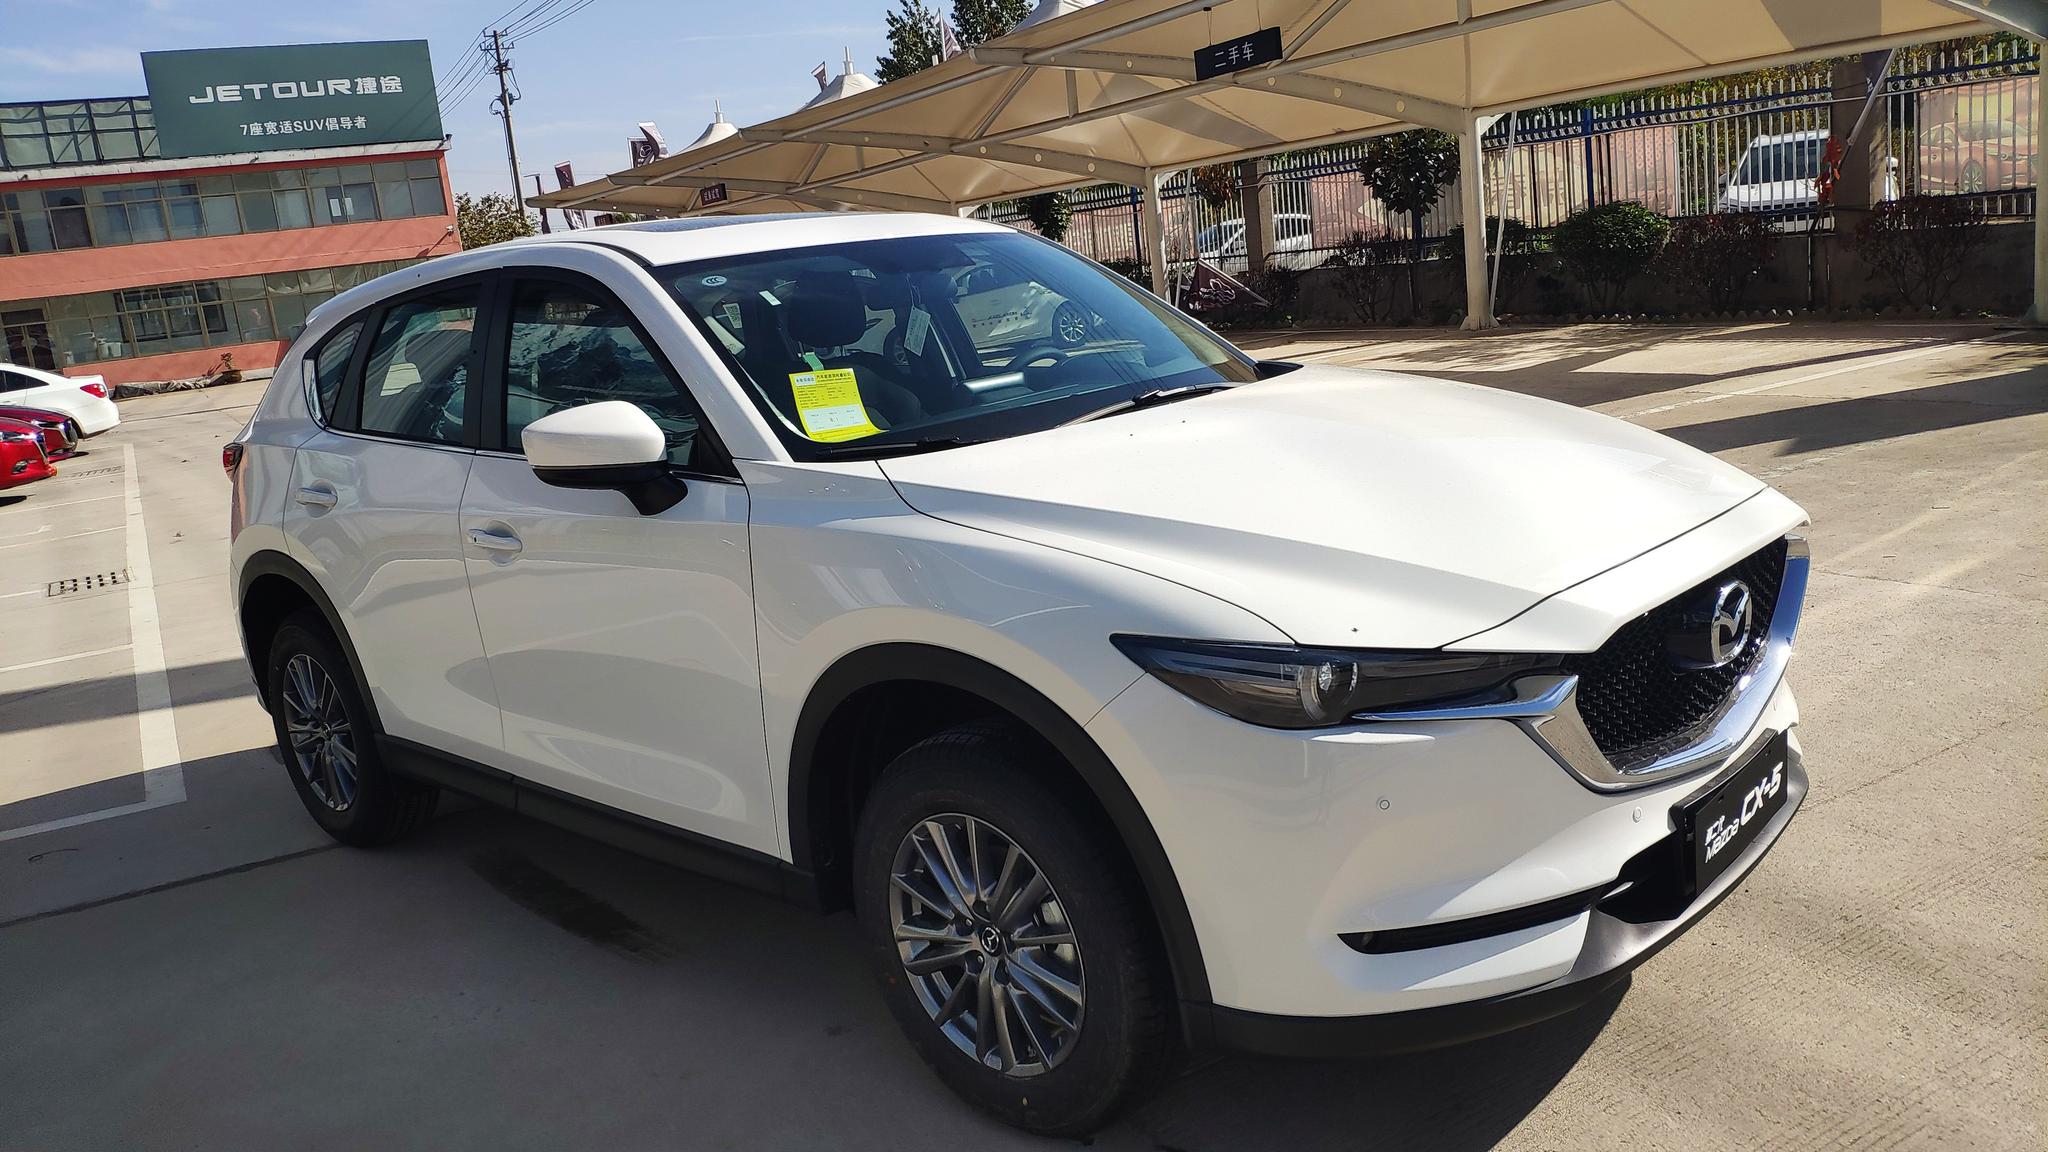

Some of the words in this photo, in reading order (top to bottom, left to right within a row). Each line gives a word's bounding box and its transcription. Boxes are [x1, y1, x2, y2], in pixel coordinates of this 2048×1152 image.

[1214, 41, 1255, 67] 二手车
[240, 115, 367, 136] 7座宽适SUV倡导者
[1741, 762, 1784, 826] CX-5
